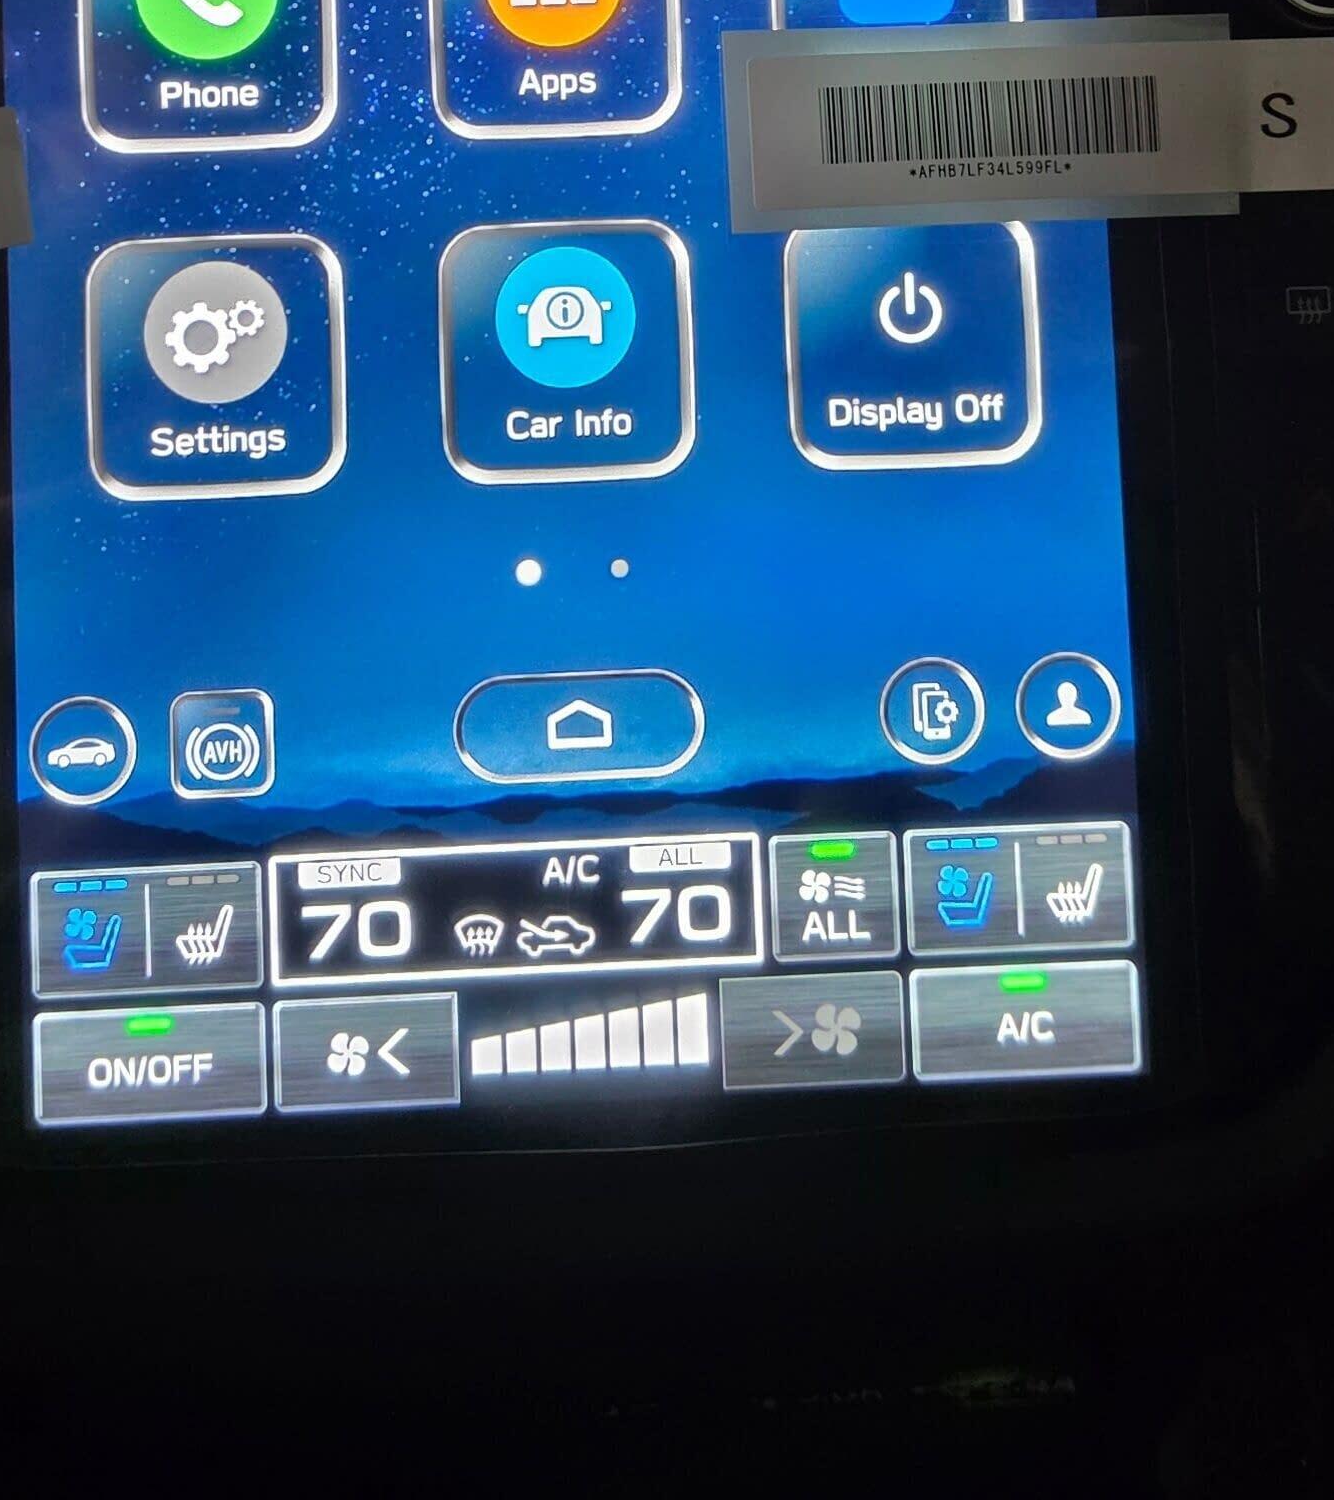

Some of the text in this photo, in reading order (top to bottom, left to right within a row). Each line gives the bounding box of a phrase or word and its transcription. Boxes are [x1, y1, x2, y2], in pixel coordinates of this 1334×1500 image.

[159, 79, 261, 111] Phone
[517, 67, 598, 103] Apps
[1260, 92, 1298, 139] S
[505, 407, 633, 441] Car Info
[827, 392, 1005, 432] Display Off
[150, 424, 287, 460] Settings
[203, 739, 243, 765] AVH
[316, 861, 384, 885] SYNC
[541, 853, 601, 887] A/C
[657, 846, 704, 868] ALL
[300, 900, 413, 960] 70
[620, 883, 733, 944] 70
[801, 910, 872, 943] ALL
[995, 1009, 1056, 1046] A/C
[86, 1051, 215, 1090] ON/OFF
